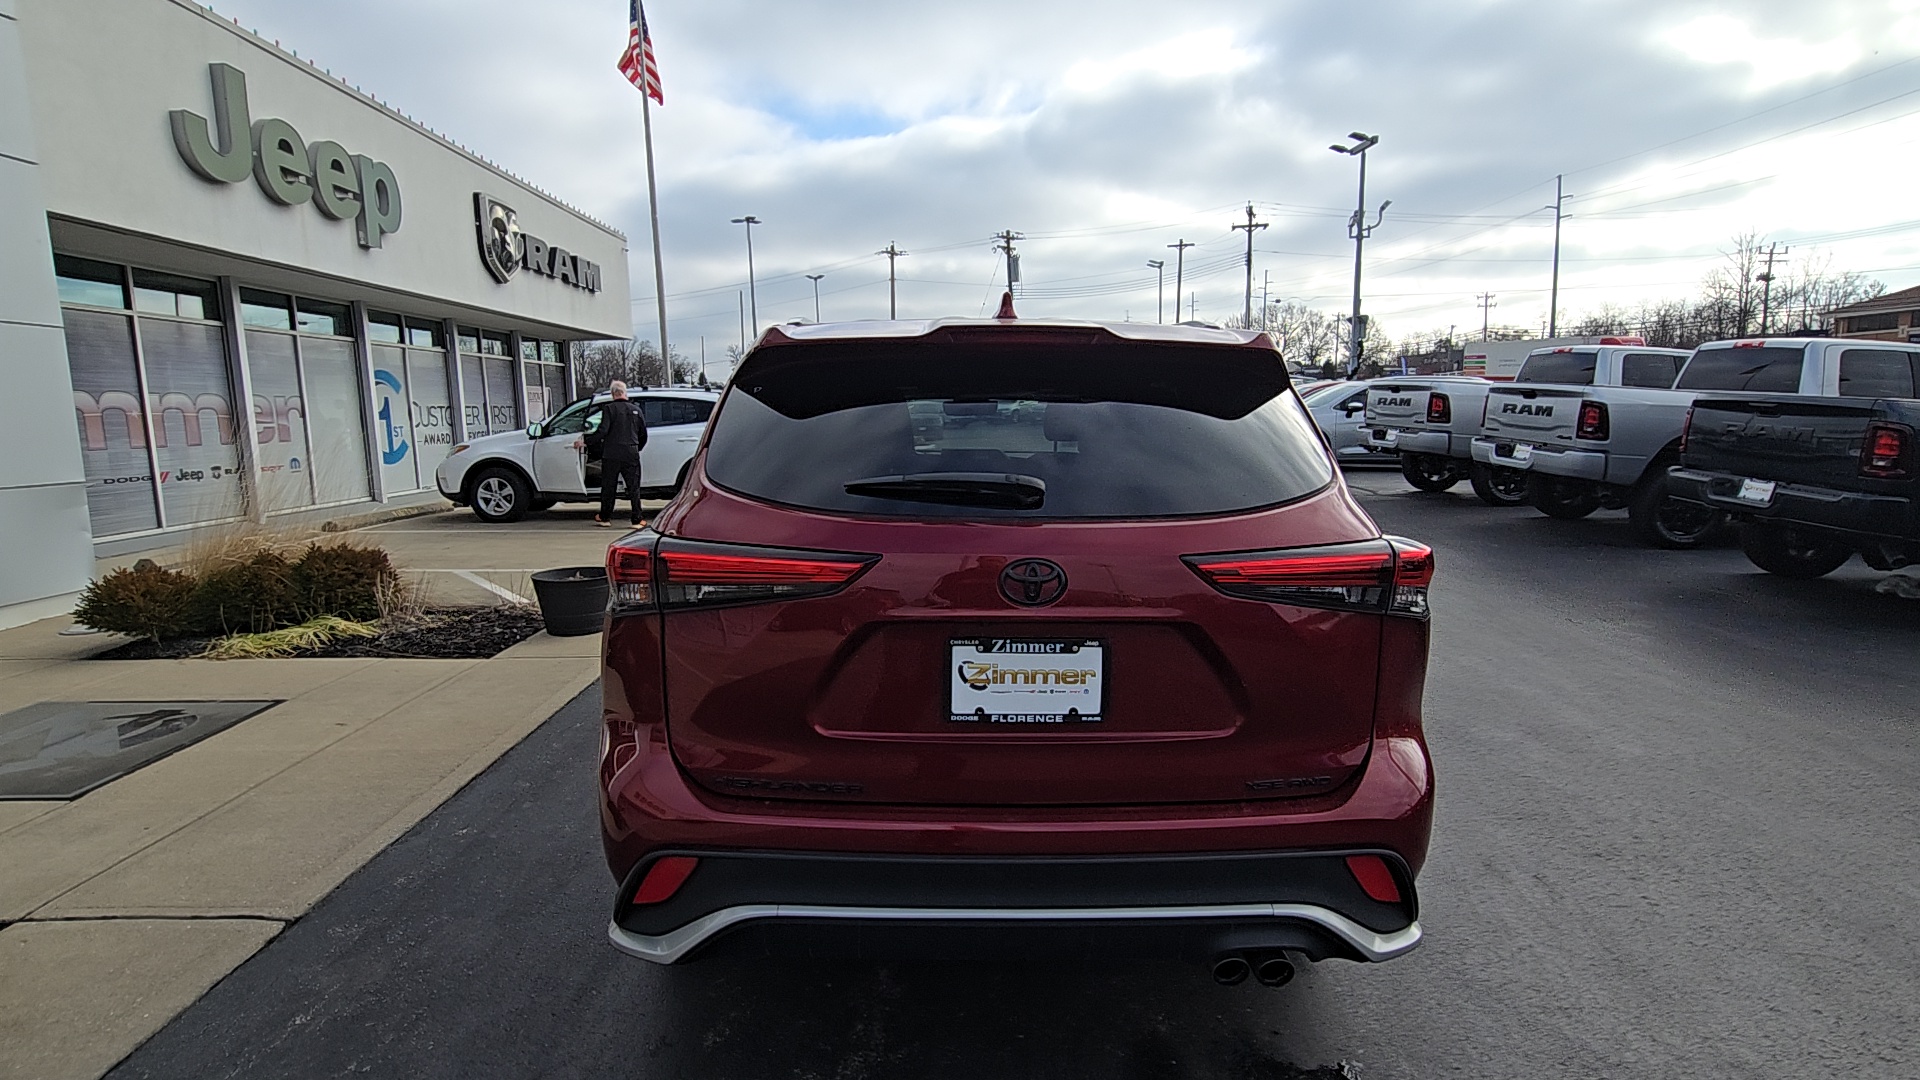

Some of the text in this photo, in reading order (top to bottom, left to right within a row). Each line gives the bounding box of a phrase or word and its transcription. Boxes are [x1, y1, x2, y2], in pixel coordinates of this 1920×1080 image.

[169, 62, 402, 248] Jeep
[521, 233, 602, 293] RAM
[1376, 397, 1412, 407] RAM
[1502, 403, 1554, 417] RAM
[423, 432, 451, 446] AWARD
[1721, 421, 1817, 446] RAM
[176, 469, 204, 482] Jeep
[991, 639, 1065, 653] Zimmer
[966, 662, 1096, 686] Zimmer
[991, 714, 1064, 723] FLORENCE
